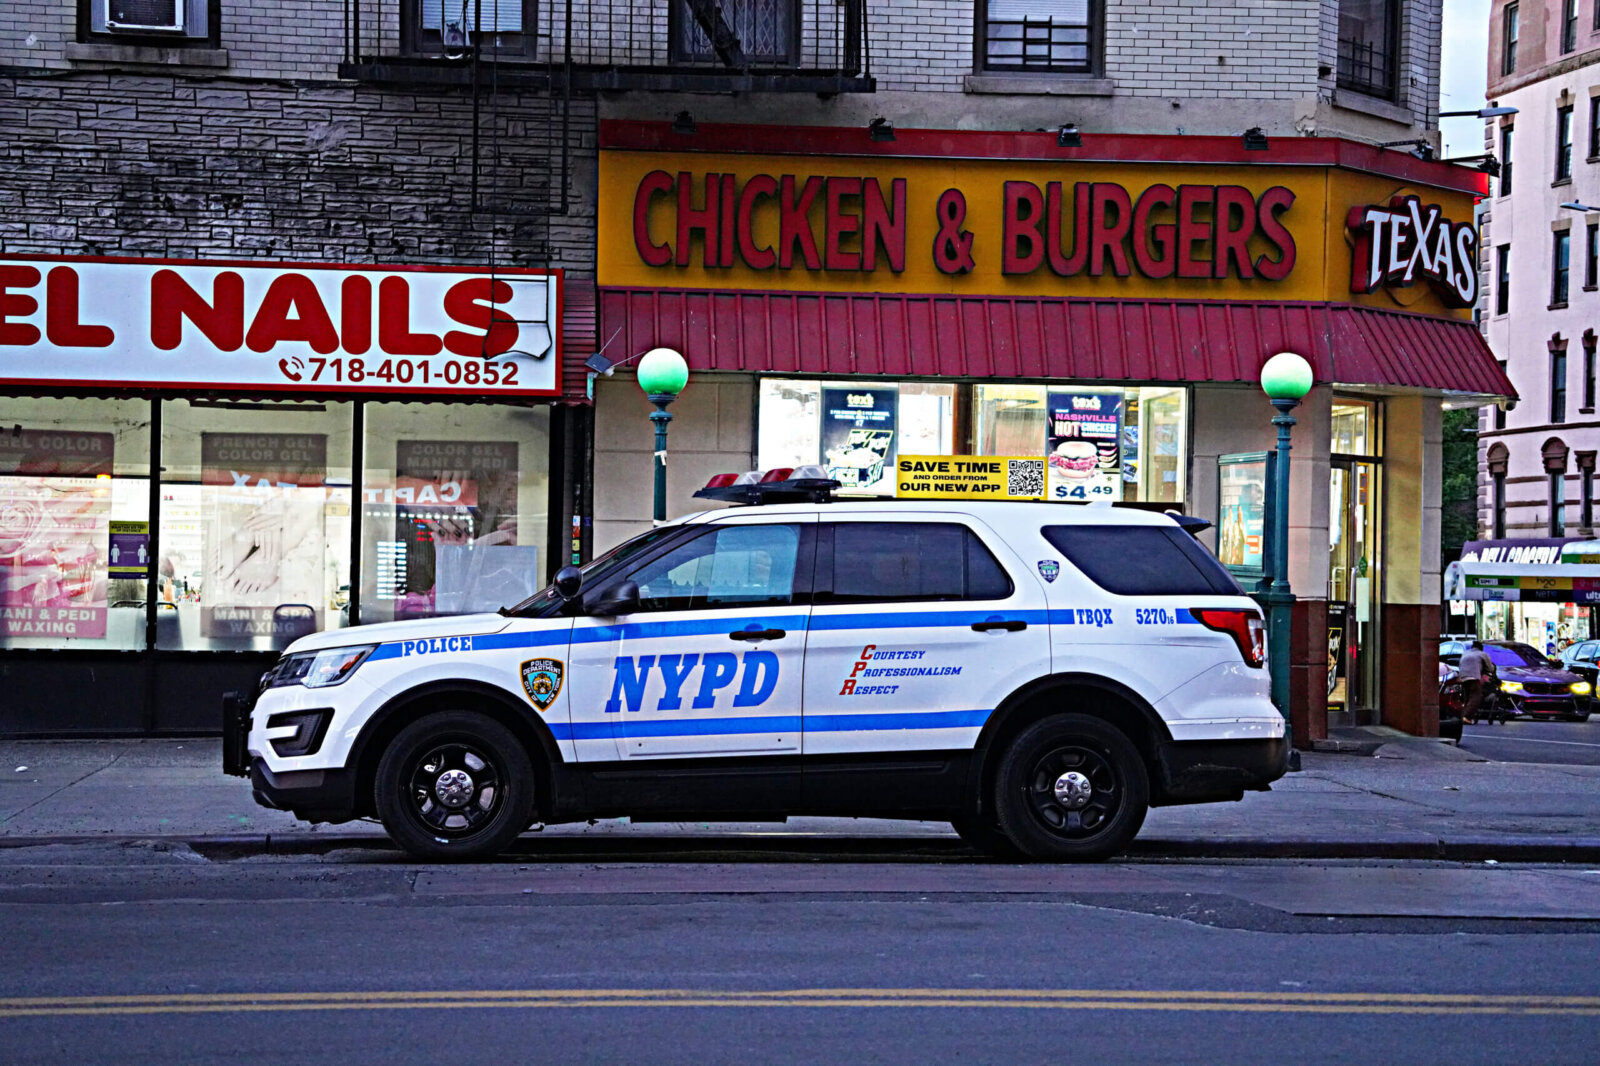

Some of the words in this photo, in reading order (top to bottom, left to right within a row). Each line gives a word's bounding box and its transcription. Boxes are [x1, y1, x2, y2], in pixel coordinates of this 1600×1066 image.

[633, 170, 907, 273] CHICKEN
[933, 188, 976, 274] &
[1002, 181, 1297, 281] BURGERS
[1365, 199, 1475, 302] TEXAS
[151, 269, 519, 357] NAILS
[308, 358, 519, 385] 718-401-0852
[1055, 413, 1116, 423] NASHVILLE
[1055, 421, 1081, 437] HOT
[40, 436, 103, 451] COLOR
[213, 437, 279, 448] FRENCH
[285, 437, 316, 449] GEL
[218, 449, 274, 461] COLOR
[280, 450, 312, 461] GEL
[411, 444, 466, 456] COLOR
[471, 445, 503, 456] GEL
[407, 456, 448, 468] MANI
[472, 457, 507, 468] PEDI
[900, 460, 950, 472] SAVE
[954, 462, 1001, 473] TIME
[900, 482, 931, 492] OUR
[934, 483, 968, 492] NEW
[971, 484, 1001, 493] APP
[0, 607, 32, 620] ANI
[39, 608, 50, 621] &
[58, 609, 97, 622] PEDI
[214, 608, 256, 620] MANI
[262, 609, 273, 620] &
[1076, 608, 1114, 628] TBQX
[8, 621, 77, 634] WAXING
[230, 622, 296, 633] WAXING
[403, 636, 471, 657] POLICE
[523, 666, 560, 675] DEPARTMENT
[604, 650, 780, 713] NYPD
